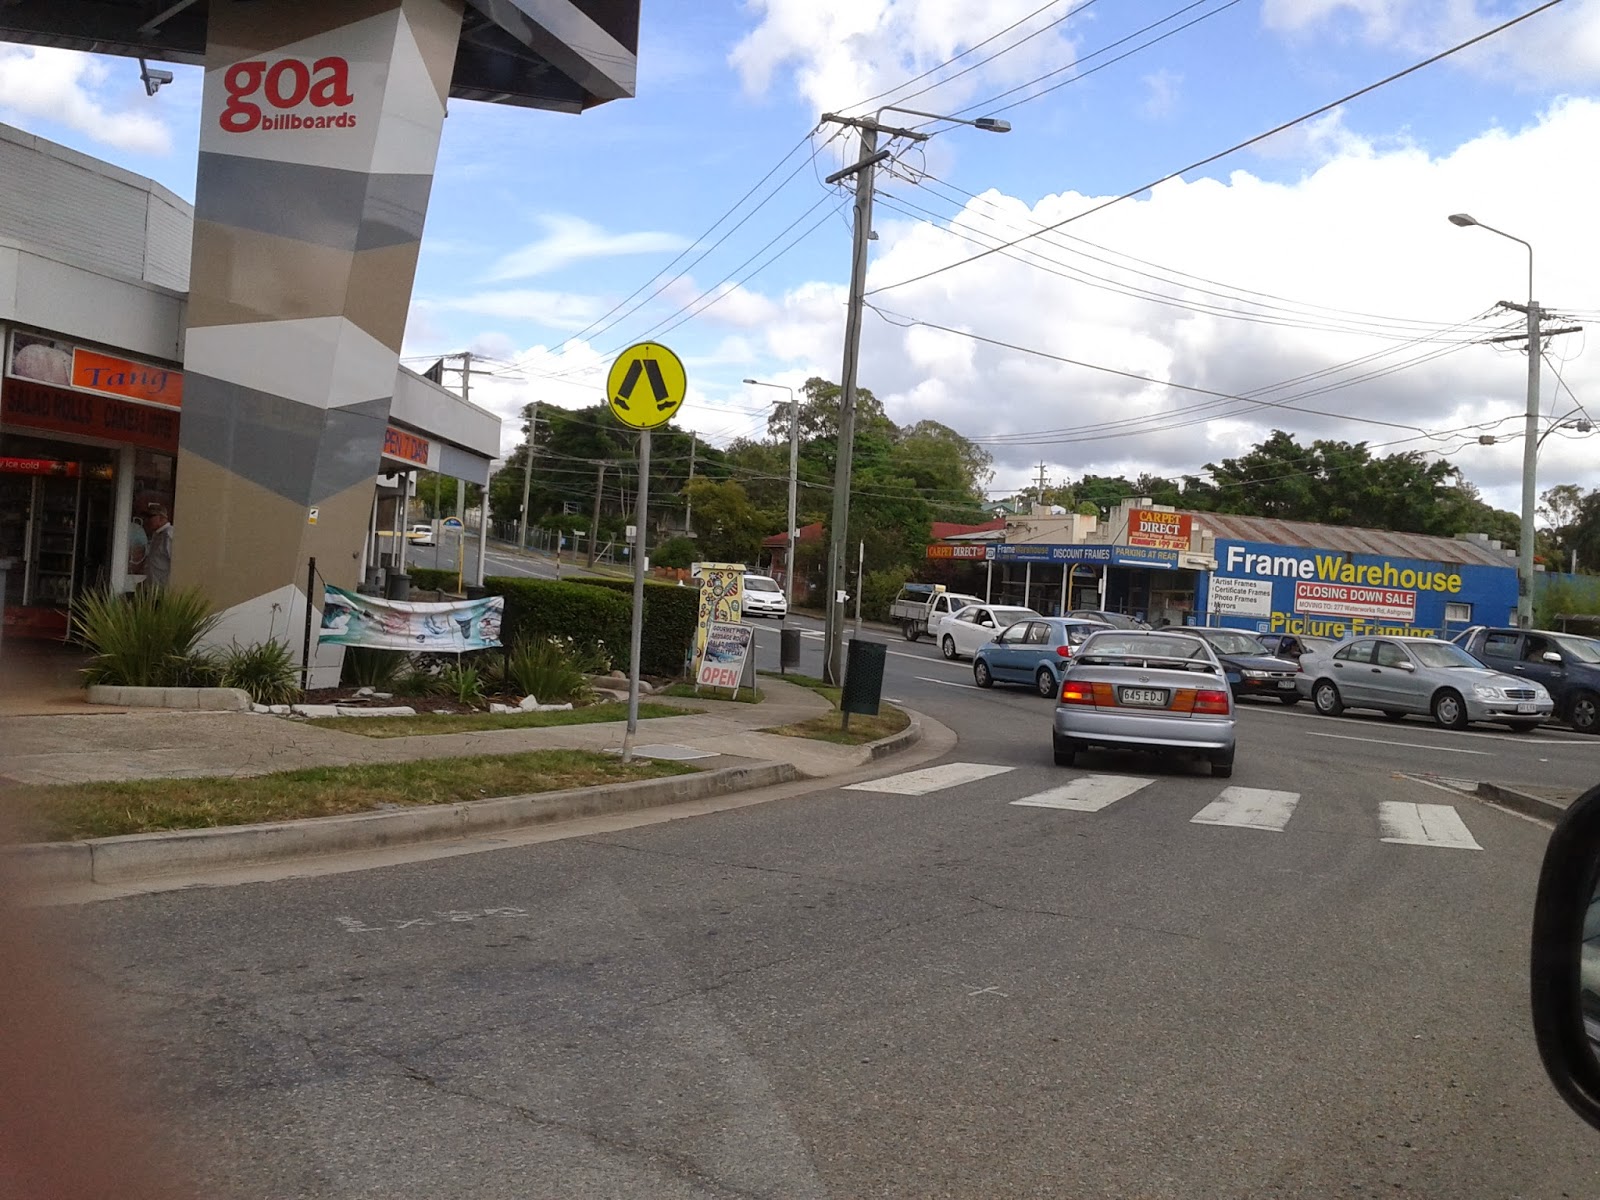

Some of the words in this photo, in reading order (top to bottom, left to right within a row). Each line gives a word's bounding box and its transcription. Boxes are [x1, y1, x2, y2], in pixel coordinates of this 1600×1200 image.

[219, 56, 354, 133] goa
[262, 112, 356, 130] billboards
[84, 368, 169, 394] Tang
[384, 430, 402, 457] PEN
[20, 462, 40, 470] cold
[1139, 511, 1182, 525] CARPET
[1139, 521, 1181, 535] DIRECT
[929, 546, 953, 557] CARPET
[953, 546, 977, 557] DIRECT
[1053, 549, 1083, 559] DISCOUNT
[1084, 549, 1110, 560] FRAMES
[1115, 547, 1146, 558] PARKING
[1147, 550, 1157, 559] AT
[1158, 550, 1178, 560] REAR
[1215, 578, 1233, 586] Artist
[1234, 580, 1257, 588] Frames
[1214, 586, 1247, 595] Certificate
[1248, 588, 1271, 597] Frames
[1214, 594, 1233, 602] Photo
[1234, 595, 1257, 603] Frames
[1298, 585, 1347, 600] CLOSING
[1350, 589, 1383, 603] DOWN
[1385, 593, 1414, 606] SALE
[1299, 601, 1322, 609] MOVING
[1333, 603, 1344, 611] 277
[1344, 604, 1376, 614] Waterworks
[1386, 608, 1412, 618] Ashgrove
[1270, 612, 1345, 638] Picure
[702, 666, 738, 686] OPEN
[1124, 690, 1141, 701] 645
[1144, 691, 1163, 702] EDJ
